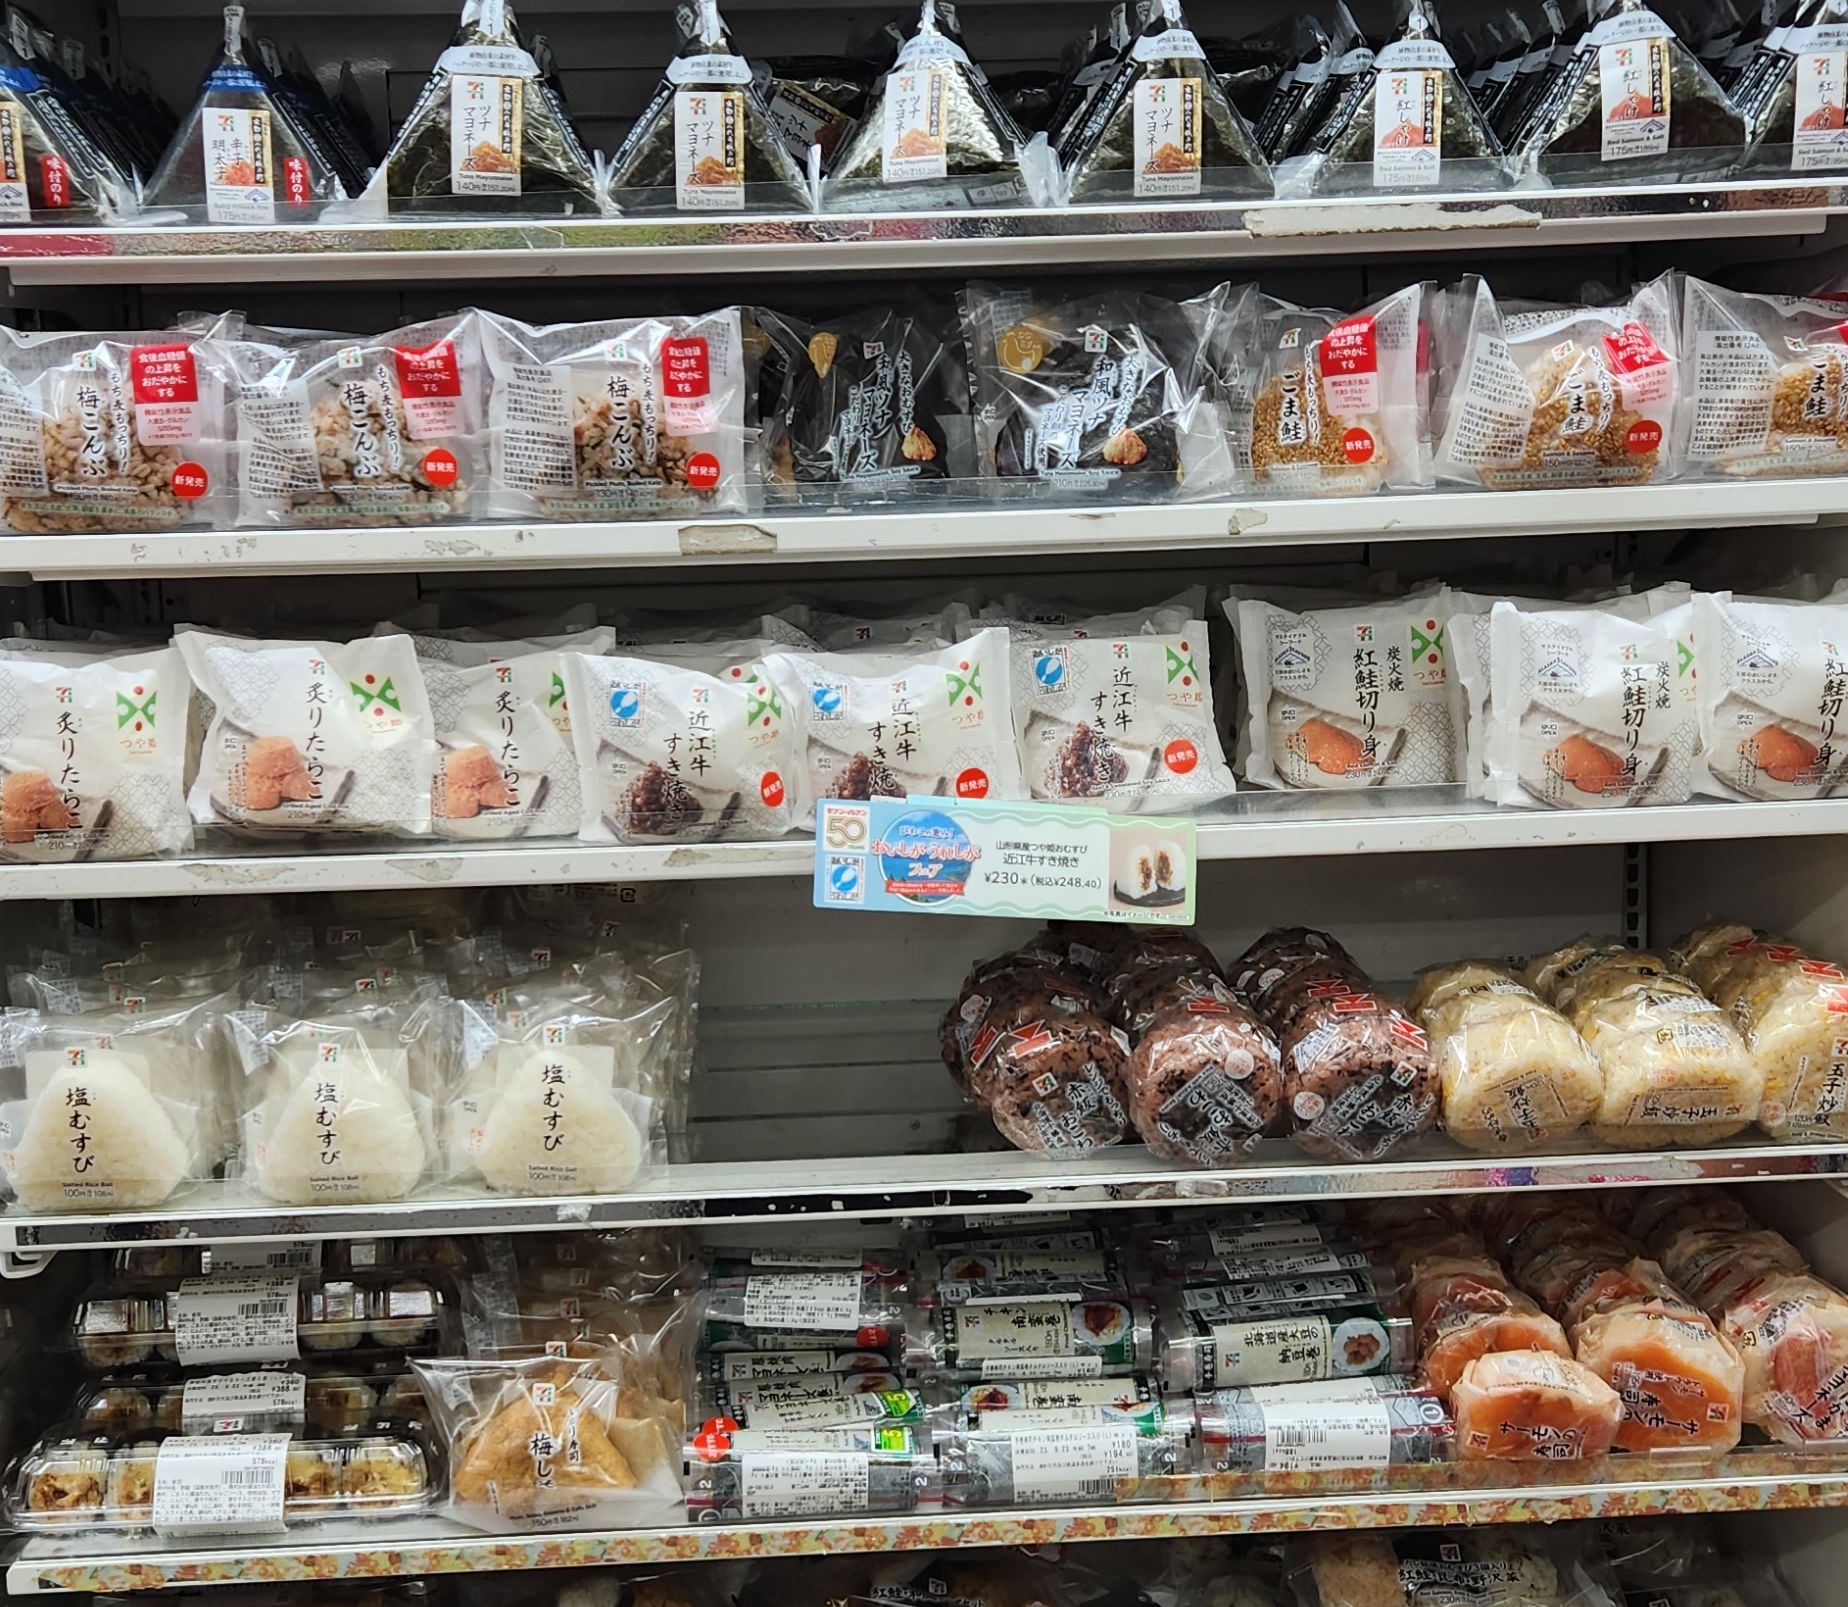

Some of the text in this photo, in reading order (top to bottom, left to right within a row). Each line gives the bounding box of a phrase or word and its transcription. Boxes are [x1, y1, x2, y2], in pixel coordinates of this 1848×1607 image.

[479, 105, 493, 131] ツナ
[908, 95, 921, 119] ツナ
[1161, 107, 1174, 133] ツナ
[701, 120, 715, 146] ツナ
[145, 363, 182, 374] の上昇を
[1327, 348, 1368, 359] おだやかに
[1340, 360, 1356, 370] する
[141, 374, 188, 386] おだやかに
[157, 386, 175, 398] する
[421, 382, 439, 393] する
[676, 382, 692, 393] する
[1088, 358, 1115, 427] 和風ツナ
[1280, 371, 1304, 443] ごま鮭
[1561, 370, 1585, 433] ごま鮭
[76, 386, 108, 478] 梅こんぶ
[344, 382, 382, 476] 梅こんぶ
[606, 375, 634, 469] 梅こんぶ
[1628, 430, 1659, 442] 新発売
[1345, 439, 1372, 451] 新発売
[174, 475, 205, 488] 新発売
[689, 465, 718, 477] 新発売
[1386, 645, 1405, 693] 炭火焼
[1654, 660, 1671, 710] 炭火焼
[1112, 666, 1134, 733] 近江牛
[1353, 649, 1381, 760] 紅鮭切り身
[552, 717, 571, 727] つや
[891, 698, 918, 761] 近江牛
[1090, 690, 1114, 783] すき焼き
[1621, 666, 1648, 777] 紅鮭切り身
[305, 682, 328, 800] 炙りたらこ
[495, 690, 520, 806] 炙りたらこ
[687, 710, 712, 777] 近江牛
[867, 721, 896, 790] すき焼
[1167, 751, 1195, 764] 新発売
[56, 710, 83, 829] 炙りたらこ
[663, 732, 687, 820] すき焼き
[959, 778, 987, 792] 新発売
[995, 839, 1088, 854] 山形県産つや姫おむすび
[1002, 853, 1080, 868] 近江牛すき焼き
[542, 1064, 566, 1152] 塩むすび
[1066, 1083, 1097, 1116] 赤飯
[65, 1087, 95, 1173] 塩むすび
[313, 1082, 341, 1165] 塩むすび
[1061, 1113, 1094, 1151] おこわ
[1243, 1326, 1321, 1348] 北海道産大豆の
[1278, 1346, 1321, 1364] 納豆巻
[1499, 1420, 1577, 1441] サーモンの
